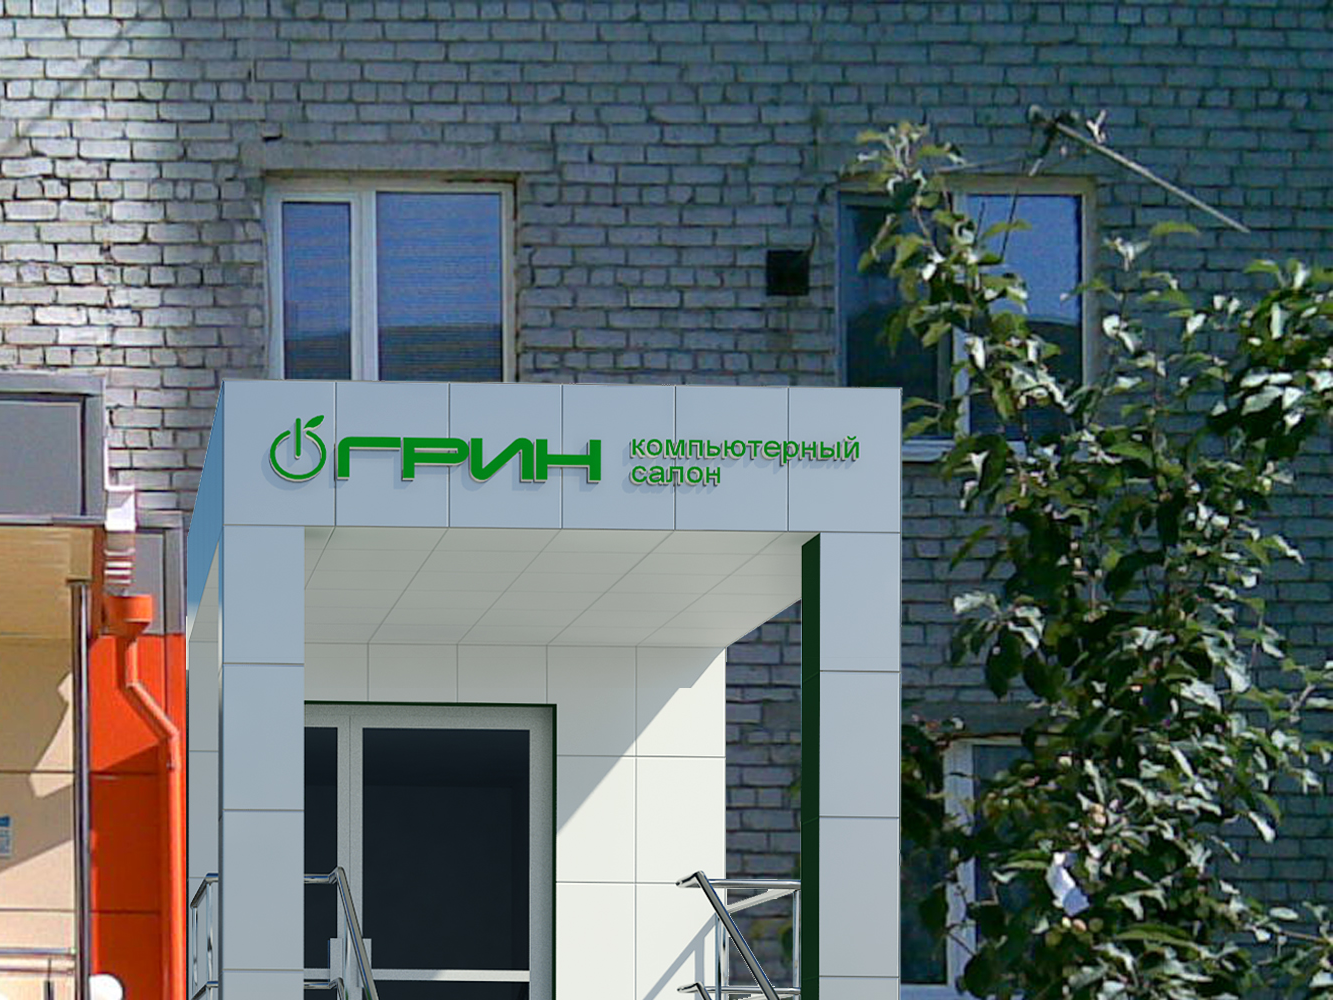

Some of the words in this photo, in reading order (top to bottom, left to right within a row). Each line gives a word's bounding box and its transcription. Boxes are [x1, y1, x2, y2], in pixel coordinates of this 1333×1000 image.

[336, 436, 603, 482] ГРИН
[631, 435, 861, 462] компьютерный
[631, 465, 722, 485] салон
